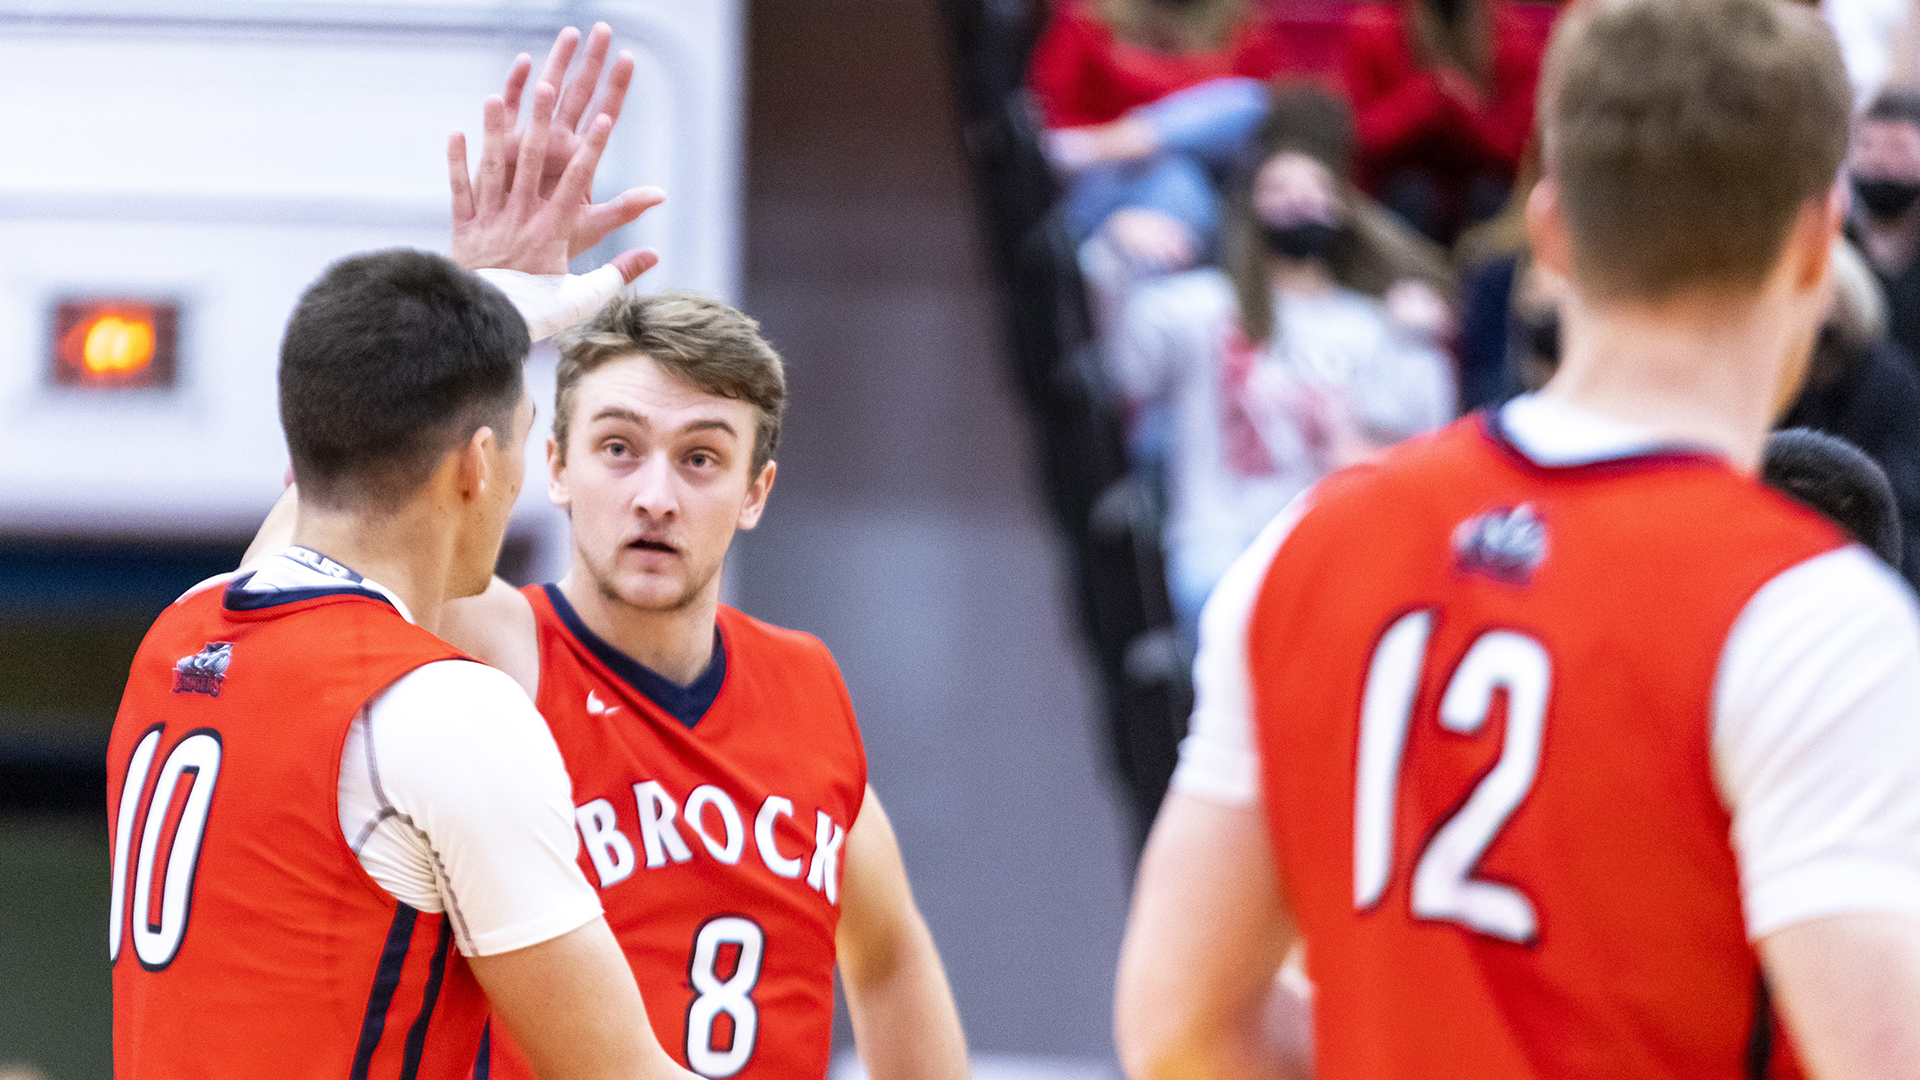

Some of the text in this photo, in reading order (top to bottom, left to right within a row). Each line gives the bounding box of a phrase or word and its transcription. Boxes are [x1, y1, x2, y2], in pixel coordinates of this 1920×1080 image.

[109, 723, 222, 972] 10
[575, 780, 844, 904] BROCK
[1353, 607, 1551, 945] 12
[684, 914, 766, 1079] 8
